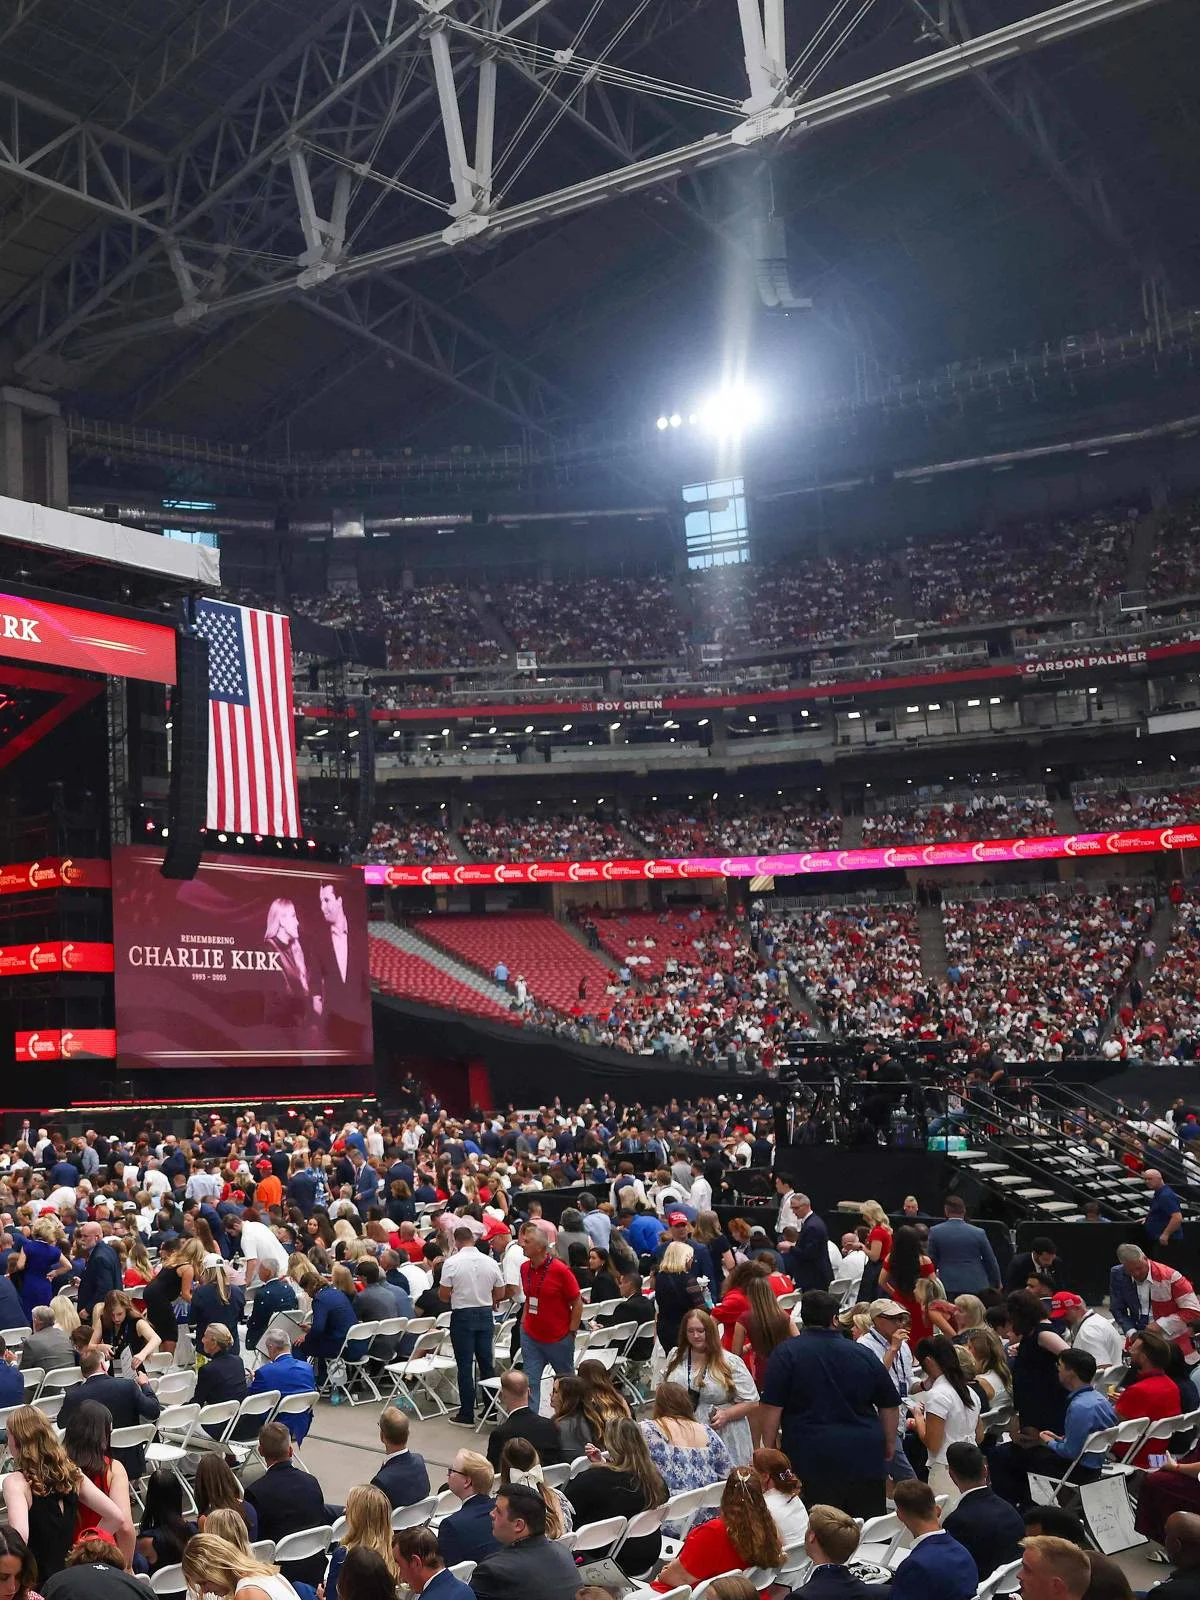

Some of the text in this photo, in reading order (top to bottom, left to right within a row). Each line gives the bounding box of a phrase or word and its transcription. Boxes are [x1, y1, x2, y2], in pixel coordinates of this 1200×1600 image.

[1026, 658, 1084, 673] CARSON
[1089, 651, 1147, 666] PALMER
[596, 702, 620, 711] ROY
[623, 700, 663, 710] GREEN
[181, 934, 235, 945] REMEMBERING
[128, 945, 283, 971] CHARLIE KIRK
